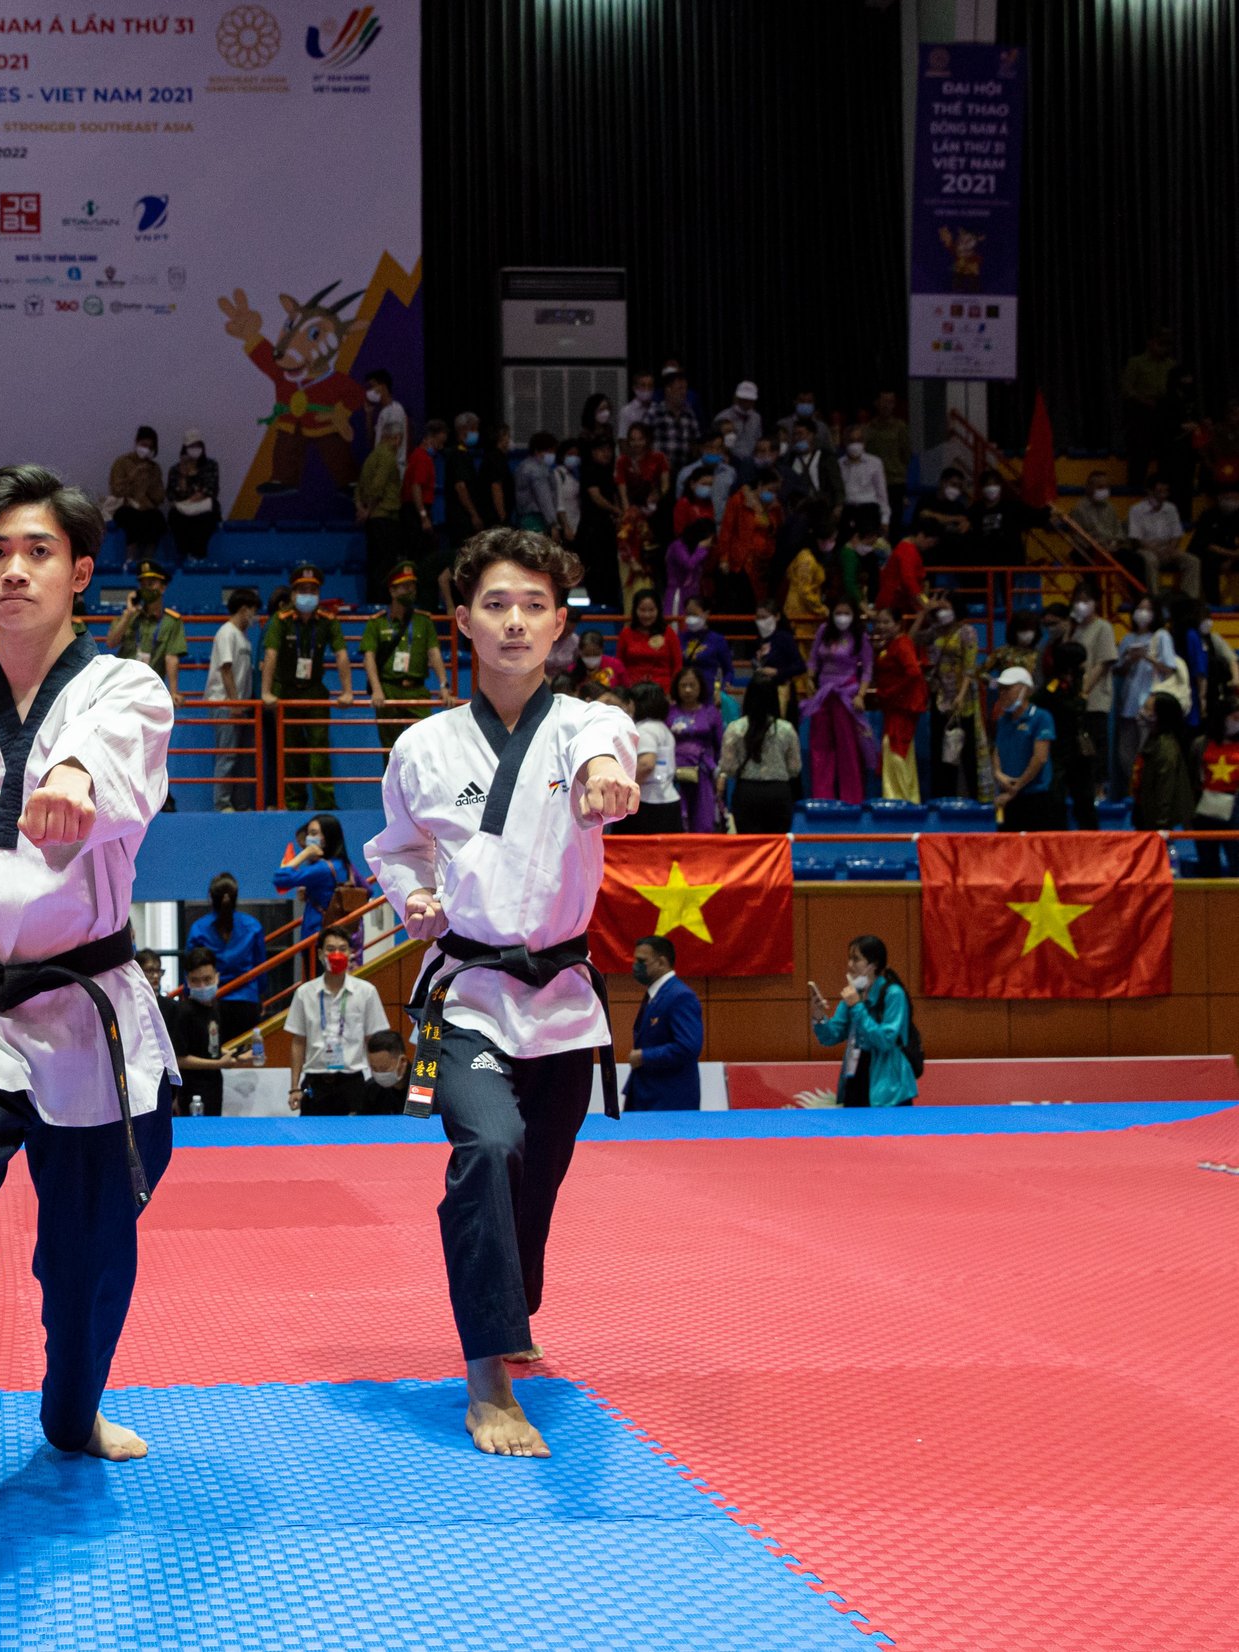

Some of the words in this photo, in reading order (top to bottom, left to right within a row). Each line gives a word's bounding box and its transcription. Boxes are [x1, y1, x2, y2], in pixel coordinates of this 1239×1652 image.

[48, 15, 64, 34] Á
[71, 13, 115, 34] LẦN
[123, 15, 169, 34] THỨ
[174, 17, 194, 34] 31
[40, 87, 87, 102] VIET
[93, 87, 142, 103] NAM
[149, 87, 193, 103] 2021
[967, 103, 1010, 117] THAO
[4, 121, 76, 133] STRONGER
[80, 121, 158, 133] SOUTHEAST
[163, 122, 194, 133] ASIA
[969, 121, 997, 135] NAM
[969, 157, 1006, 171] NAM
[941, 173, 996, 194] 2021
[455, 795, 488, 806] adida
[471, 1060, 504, 1074] adidas
